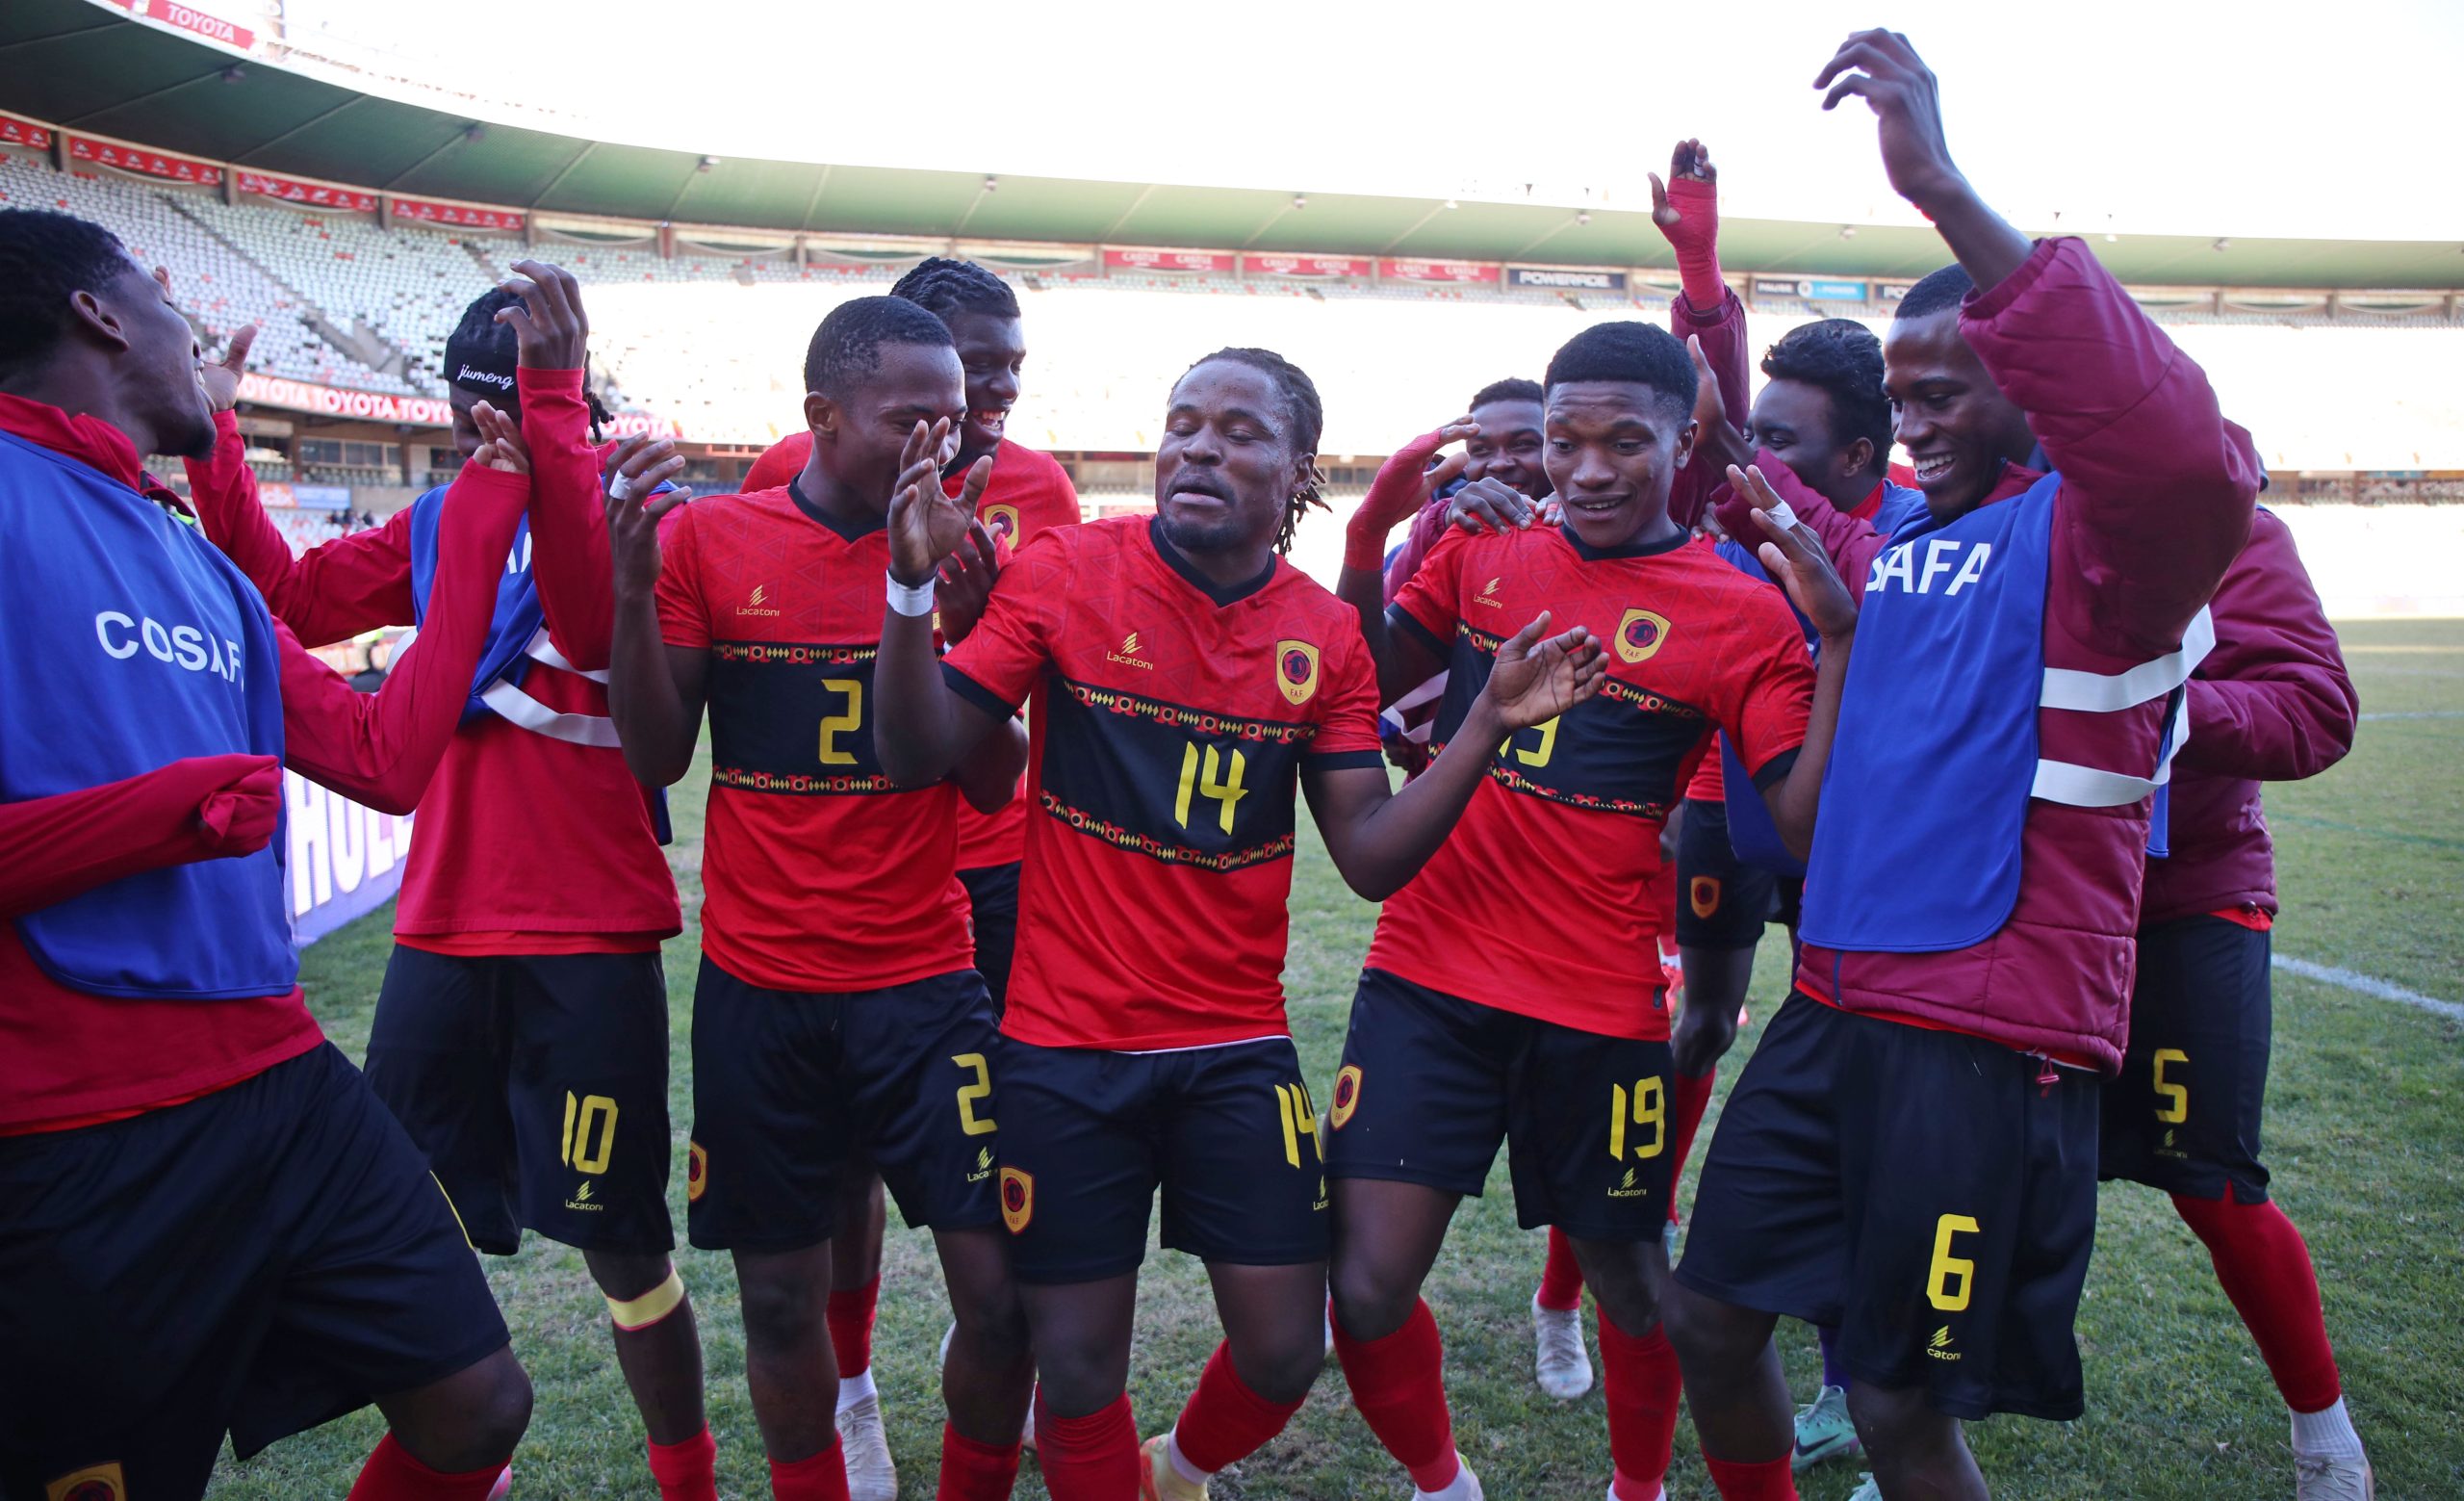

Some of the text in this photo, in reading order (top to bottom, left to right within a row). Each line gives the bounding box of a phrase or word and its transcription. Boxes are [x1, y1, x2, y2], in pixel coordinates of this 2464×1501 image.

[167, 5, 235, 41] TOYOTA
[242, 375, 676, 438] OYOTA TOYOTA TOY OYOTA
[736, 606, 780, 617] Lacatoni
[1474, 593, 1502, 609] Lacatoni
[95, 610, 244, 692] COSAF
[1107, 650, 1154, 671] Lacatoni
[819, 679, 862, 764] 2
[1175, 740, 1249, 837] 14
[951, 1052, 998, 1135] 2
[1609, 1075, 1665, 1161] 19
[2154, 1048, 2190, 1124] 5
[562, 1090, 619, 1175] 10
[1274, 1081, 1323, 1169] 14
[565, 1199, 604, 1211] Lacatoni
[1607, 1187, 1647, 1197] Lacatoni
[1926, 1213, 1980, 1311] 6
[1926, 1347, 1962, 1360] catoni
